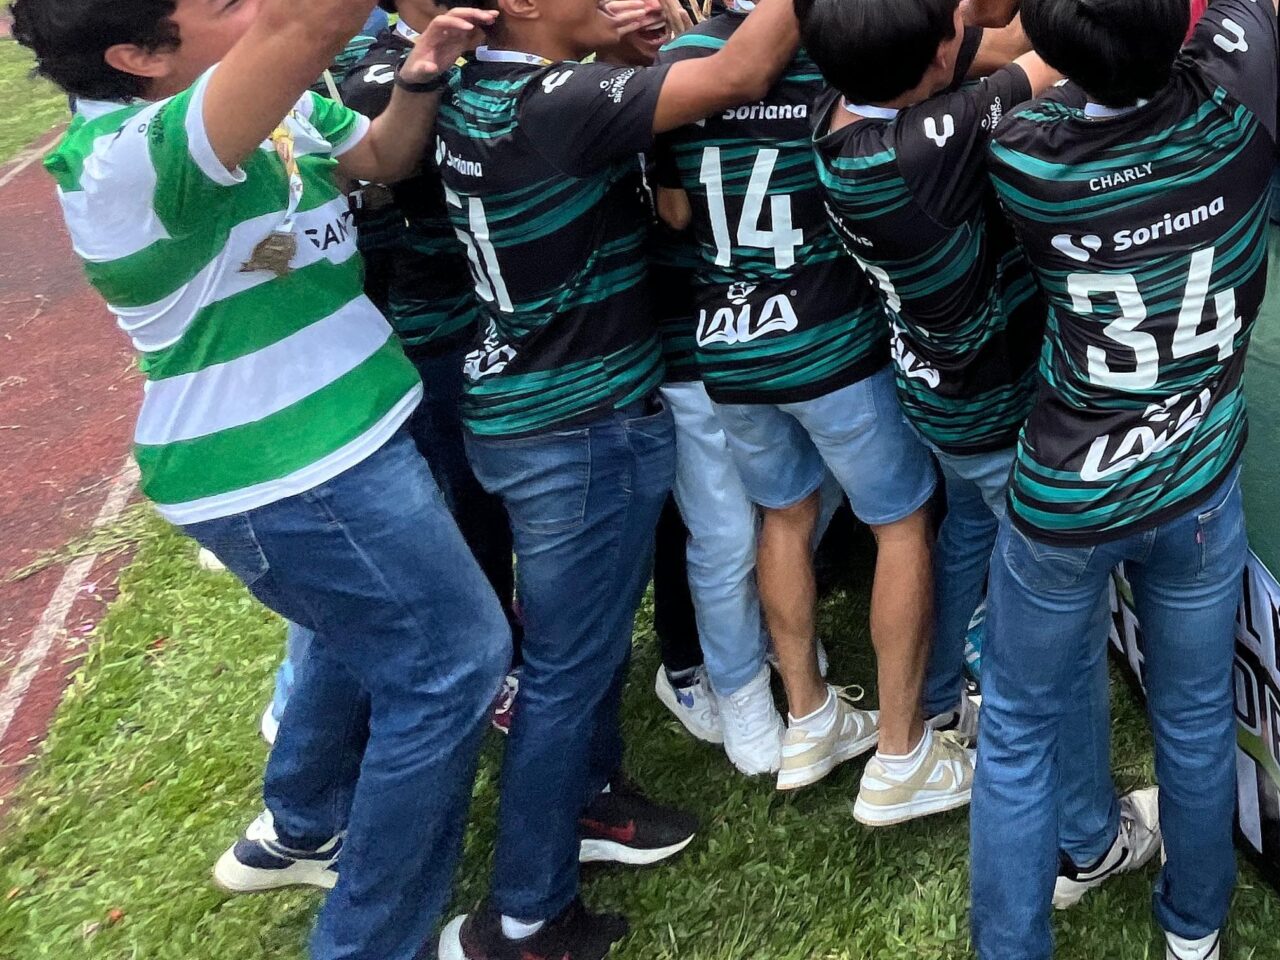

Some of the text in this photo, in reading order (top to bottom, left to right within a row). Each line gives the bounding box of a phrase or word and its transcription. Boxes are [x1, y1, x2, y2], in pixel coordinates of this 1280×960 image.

[722, 101, 807, 120] Soriana
[1089, 162, 1154, 192] CHARLY
[699, 147, 803, 269] 14
[1113, 196, 1225, 252] Soriana
[1067, 246, 1242, 390] 34
